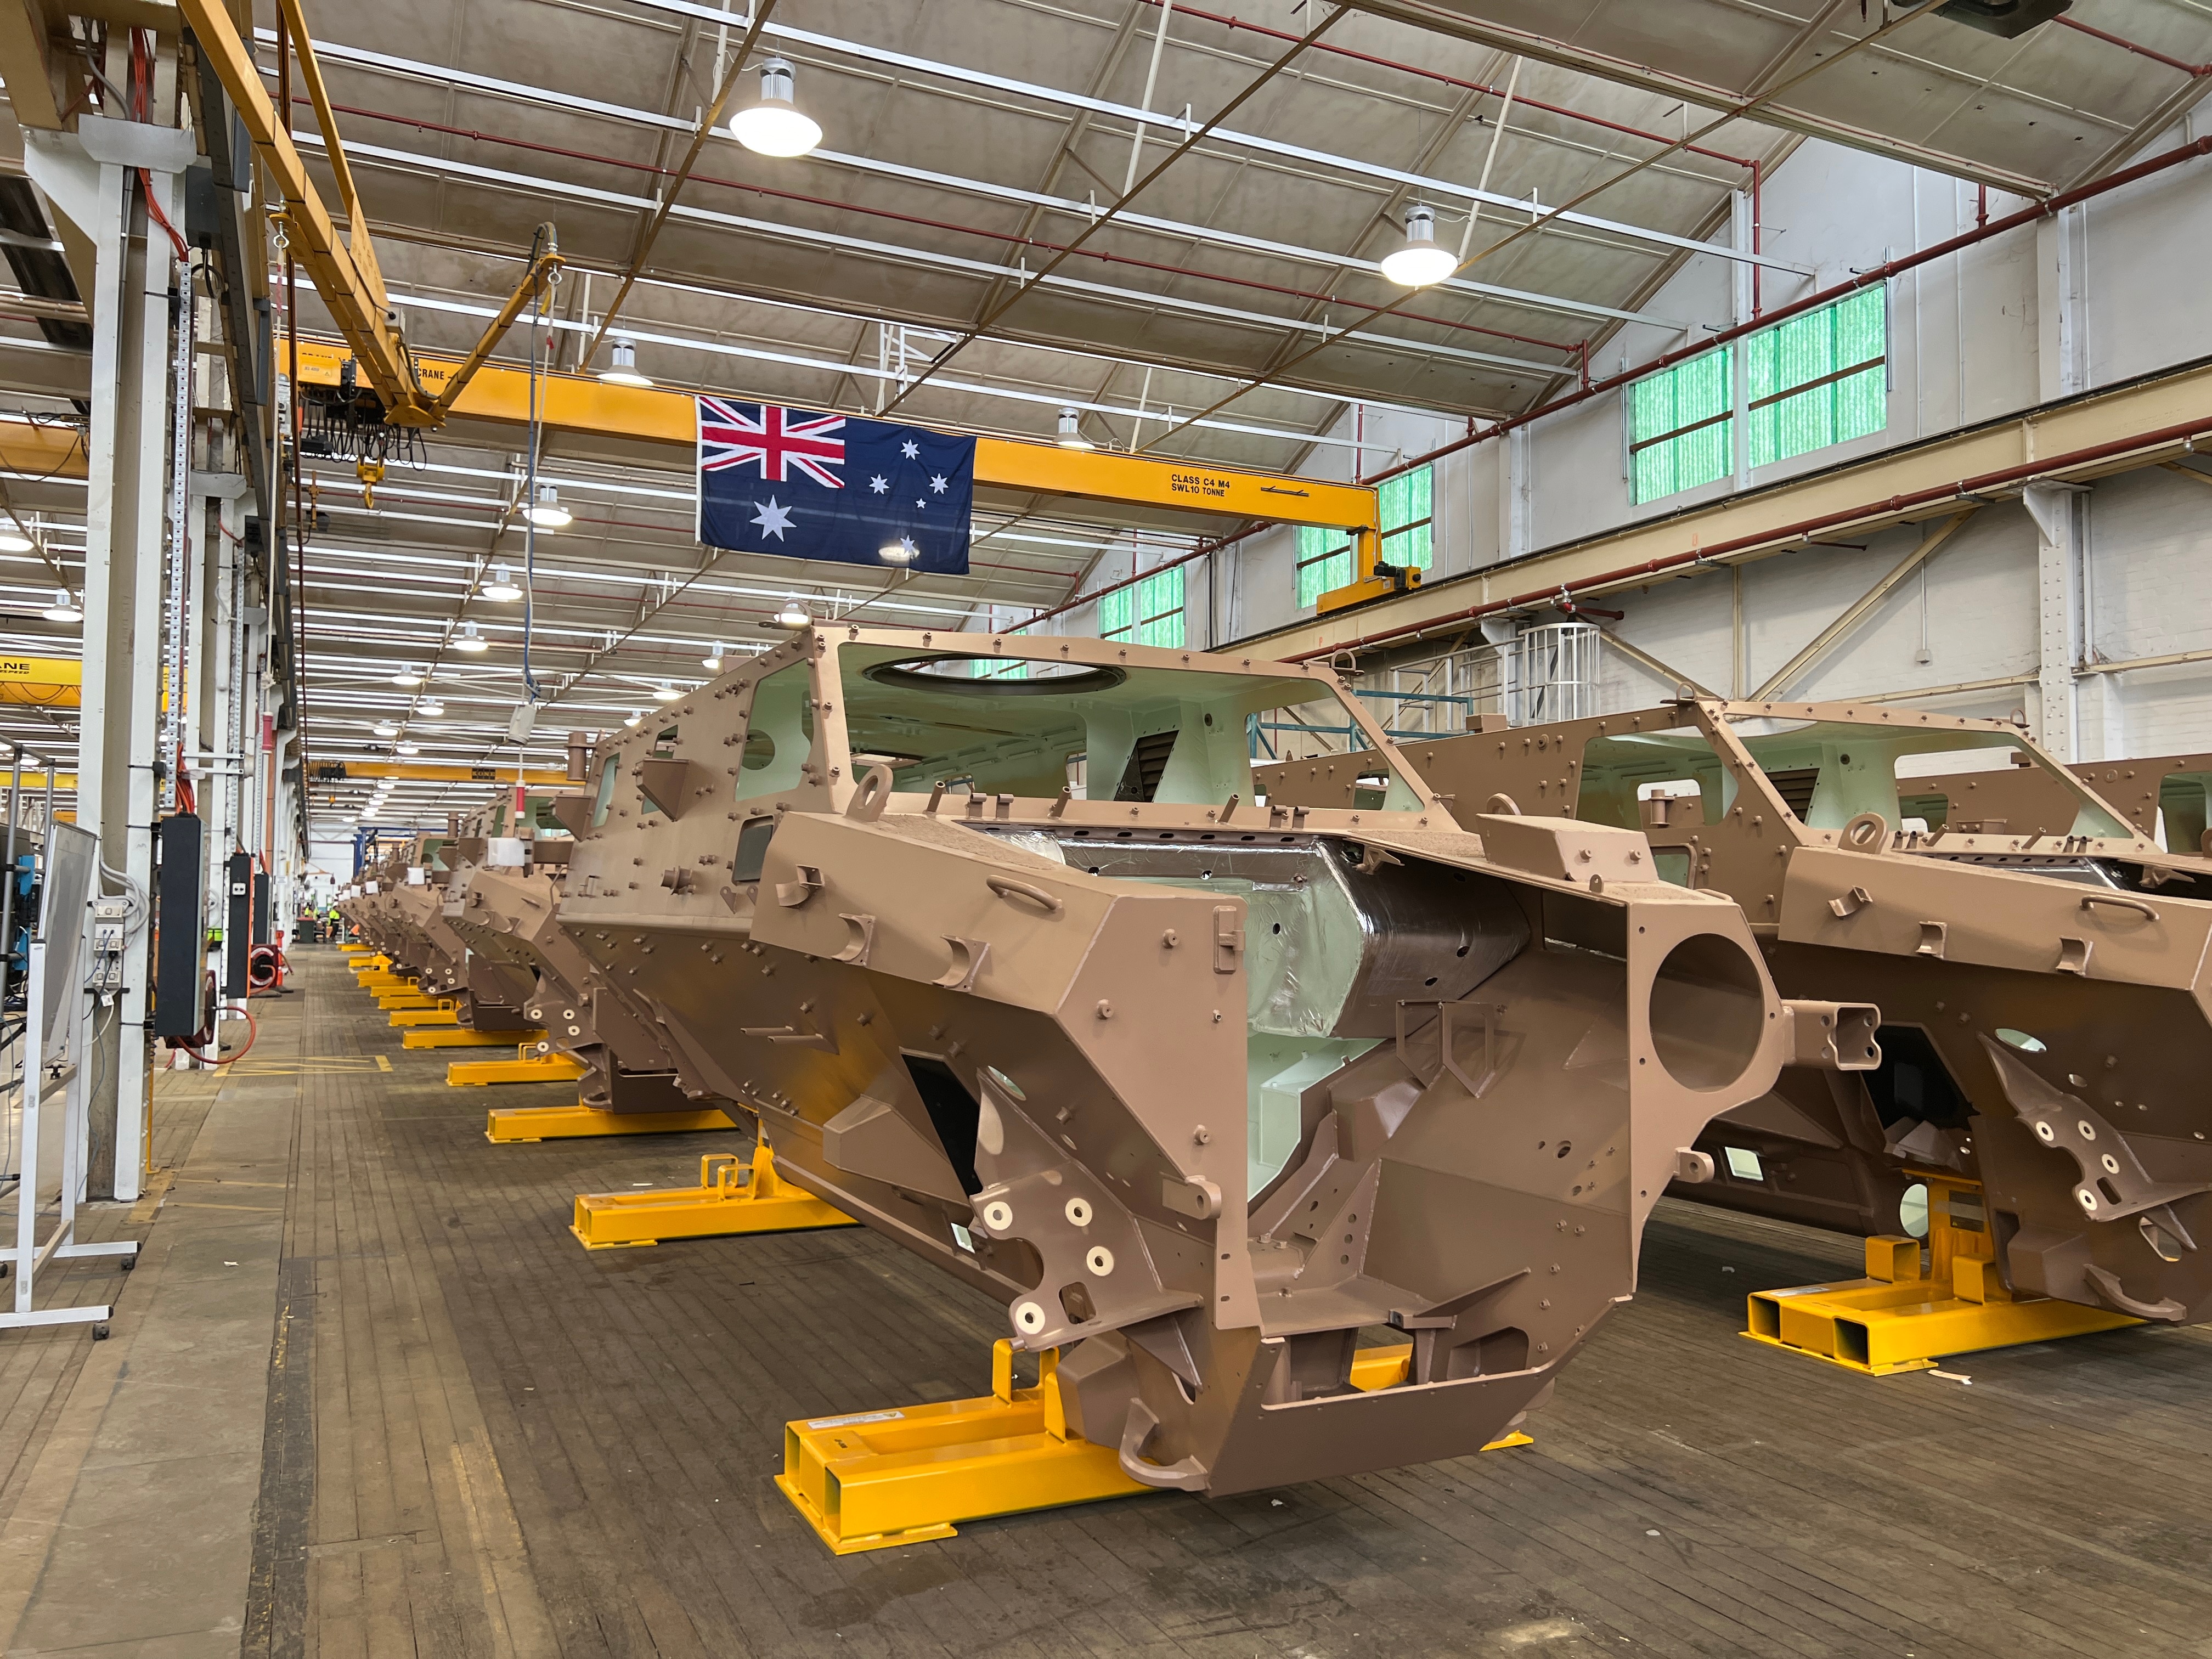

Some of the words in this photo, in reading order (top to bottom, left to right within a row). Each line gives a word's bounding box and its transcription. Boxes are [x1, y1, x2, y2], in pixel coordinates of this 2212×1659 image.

[1172, 474, 1200, 484] CLASS
[1204, 478, 1215, 487] C4
[1218, 480, 1230, 488] M4
[1203, 487, 1224, 496] TONNE
